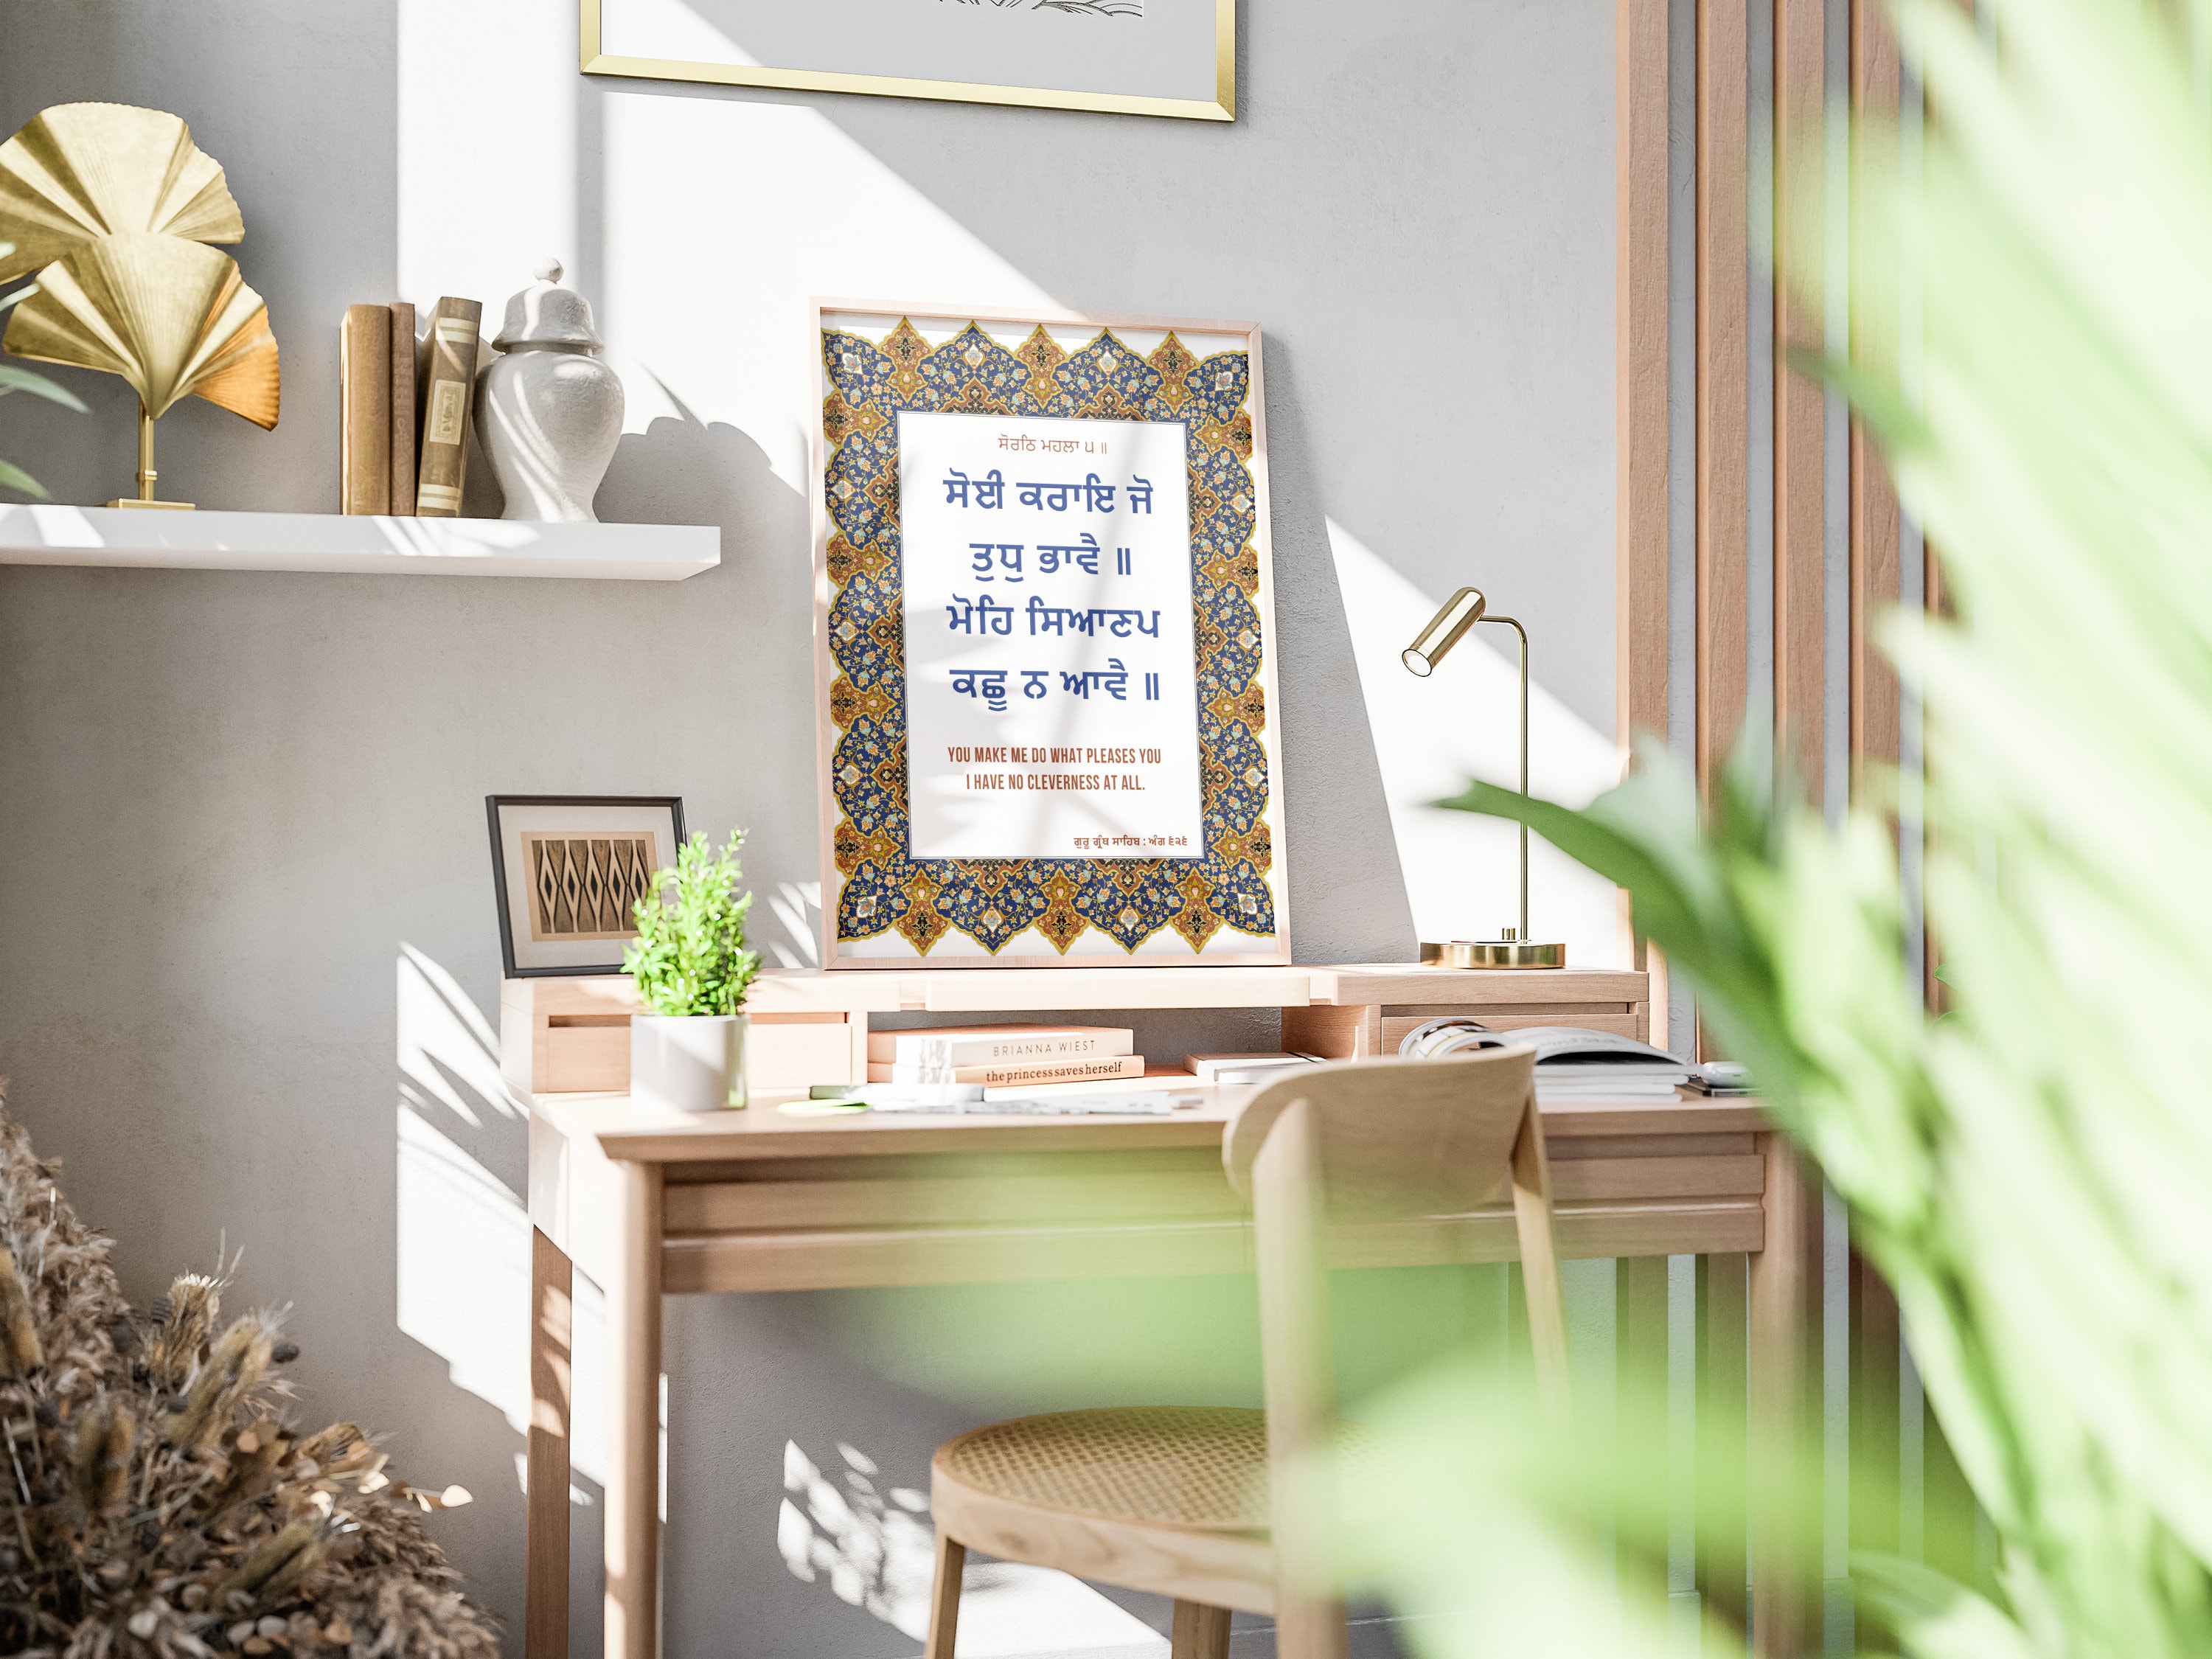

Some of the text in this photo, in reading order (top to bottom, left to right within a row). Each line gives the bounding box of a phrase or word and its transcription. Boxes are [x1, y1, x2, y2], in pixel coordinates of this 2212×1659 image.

[998, 433, 1036, 451] ਸੋਰਠਿ
[1040, 440, 1079, 453] ਮਹਲਾ
[943, 467, 1153, 514] ਸੋਈ ਕਰਾਇ ਜੋ
[969, 543, 1024, 582] ਤੁਧੁ
[1037, 532, 1101, 575] ਭਾਵੈ
[946, 593, 1161, 638] ਮੋਹਿ ਸਿਆਣਪ
[949, 669, 1008, 712] ਕਛੂ
[1020, 670, 1049, 699] ਨ
[1060, 658, 1129, 700] ਆਵੈ
[947, 746, 1161, 764] YOU MAKE ME DO WHAT PLEASES YOU
[966, 773, 1145, 790] I HAVE NO CLEVERNESS AT ALL.
[1074, 838, 1090, 849] ਗੁਰੂ
[1112, 835, 1140, 846] ਸਾਹਿਬ
[1148, 835, 1165, 846] ਅੰਗ
[992, 1040, 1096, 1057] BRIANNA WIEST
[987, 1062, 1122, 1083] the princess saves herself
